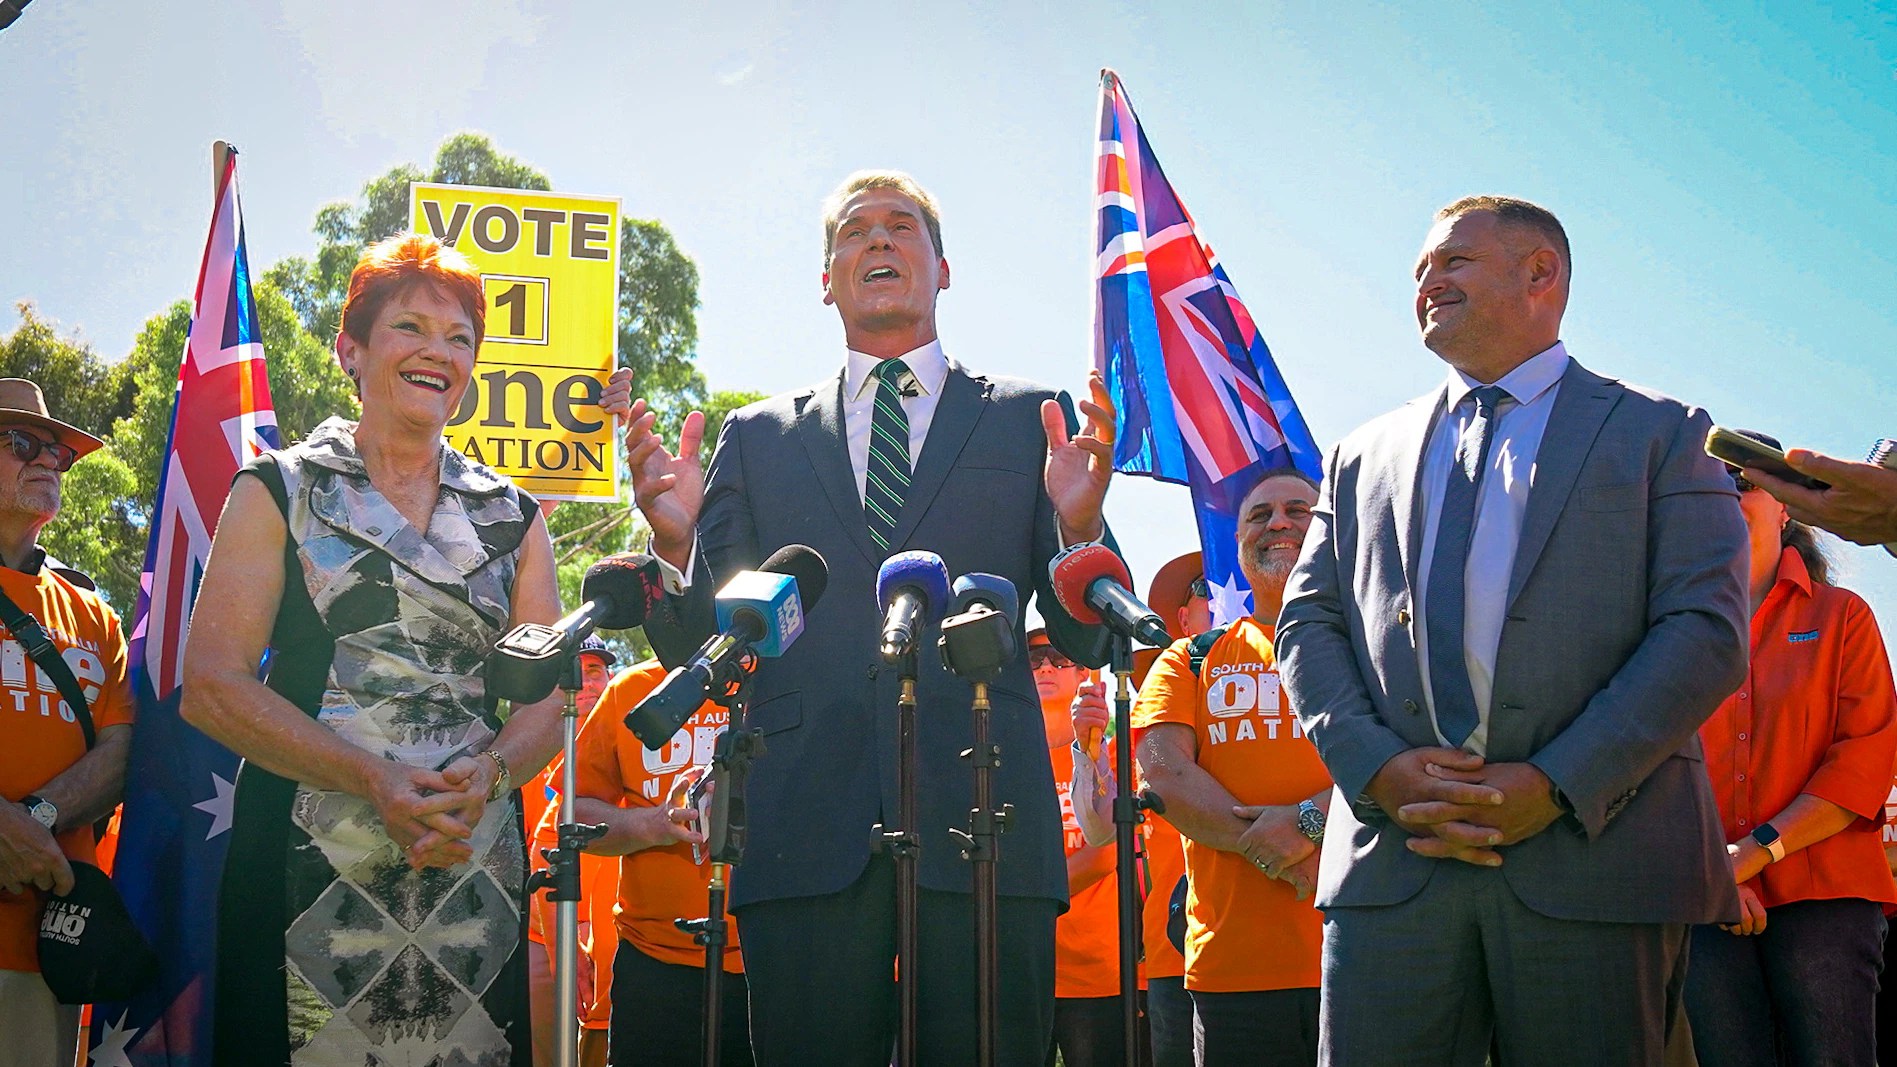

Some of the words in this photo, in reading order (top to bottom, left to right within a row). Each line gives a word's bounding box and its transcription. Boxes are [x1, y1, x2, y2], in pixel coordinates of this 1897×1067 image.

[422, 201, 610, 260] VOTE
[495, 284, 527, 336] 1
[444, 435, 606, 472] ATION
[1062, 547, 1104, 572] news
[776, 605, 788, 642] NEWS
[1210, 662, 1264, 678] SOUTH
[8, 689, 77, 723] TIO
[1207, 718, 1301, 745] NATI
